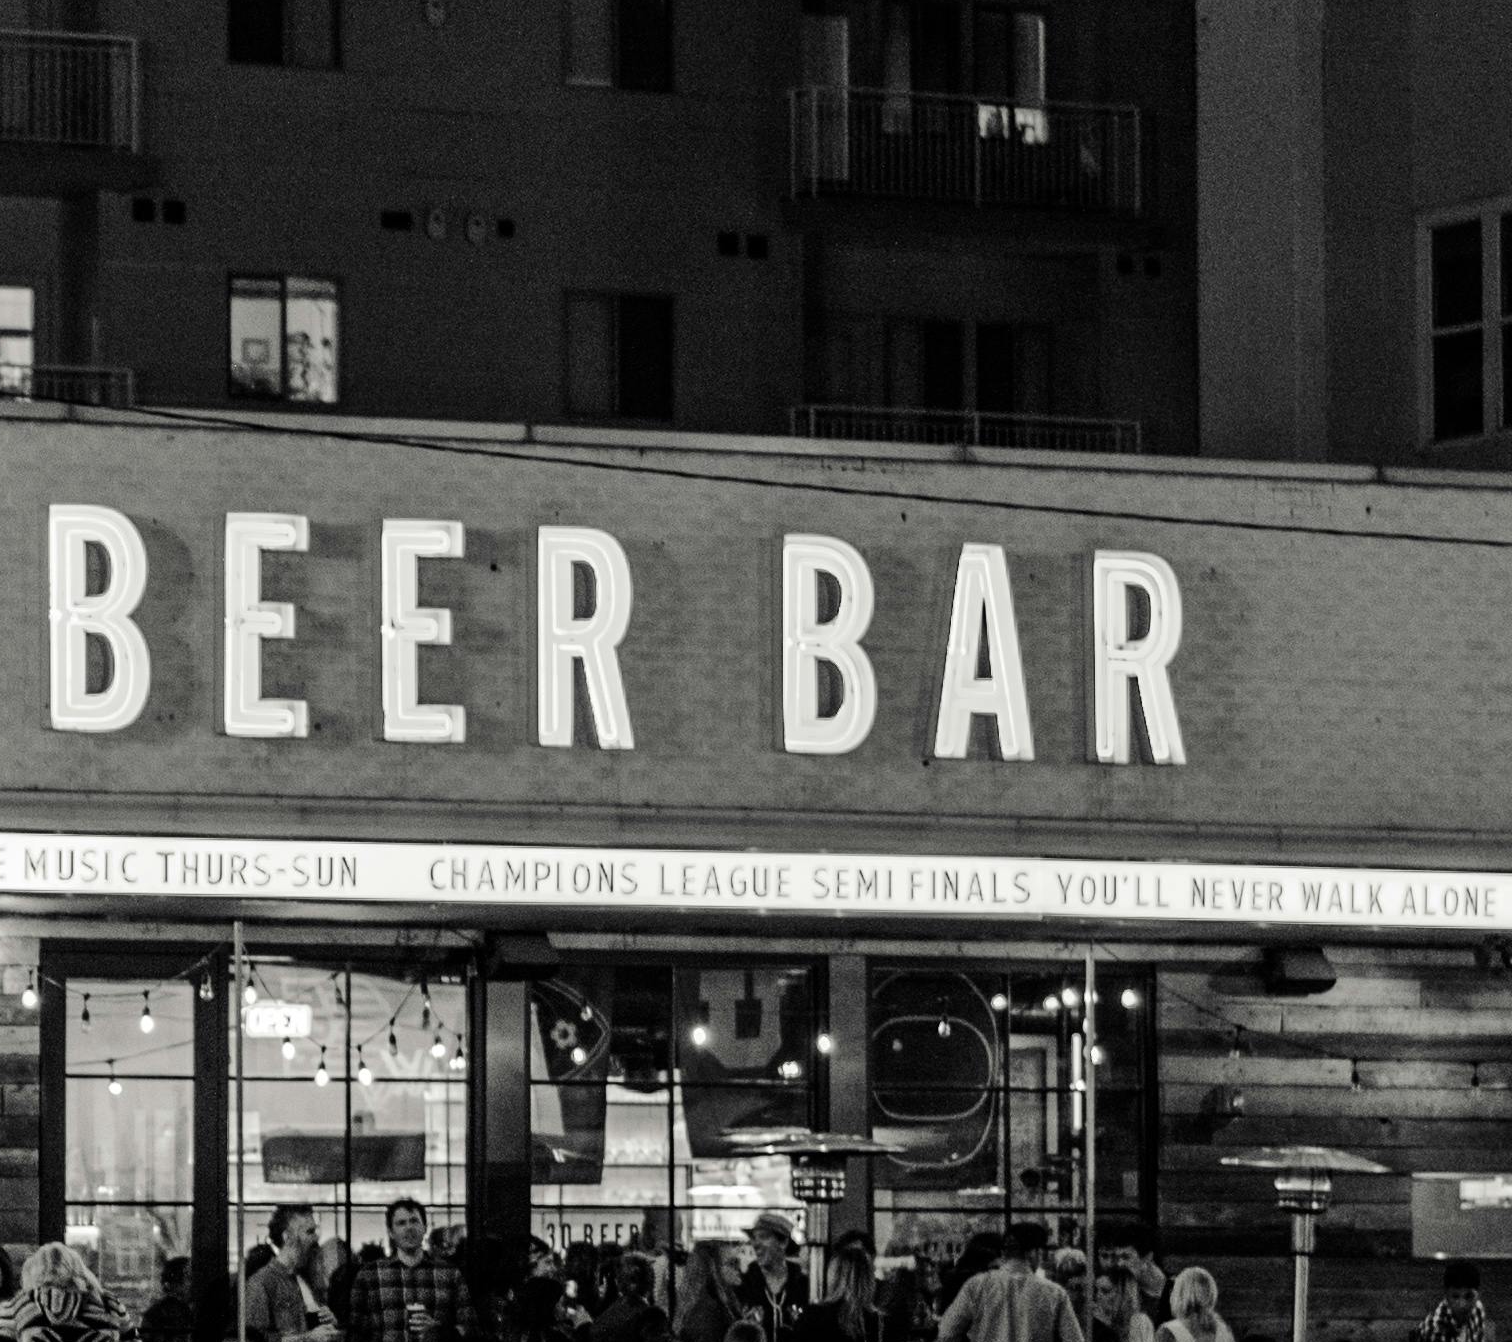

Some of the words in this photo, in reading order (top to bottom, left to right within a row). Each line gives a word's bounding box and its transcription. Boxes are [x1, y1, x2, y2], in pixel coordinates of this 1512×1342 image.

[47, 504, 634, 749] BEER
[783, 534, 1187, 764] BAR
[24, 848, 139, 884] MUSIC
[156, 851, 358, 889] THURS-SUN
[429, 858, 639, 895] CHAMPIONS
[660, 862, 792, 899] LEAGUE
[813, 866, 895, 902] SEMI
[910, 869, 1031, 905] FINALS
[1057, 873, 1170, 909] YOU'LL
[1191, 877, 1284, 912] NEVER
[1302, 880, 1384, 916] WALK
[1401, 884, 1498, 919] ALONE
